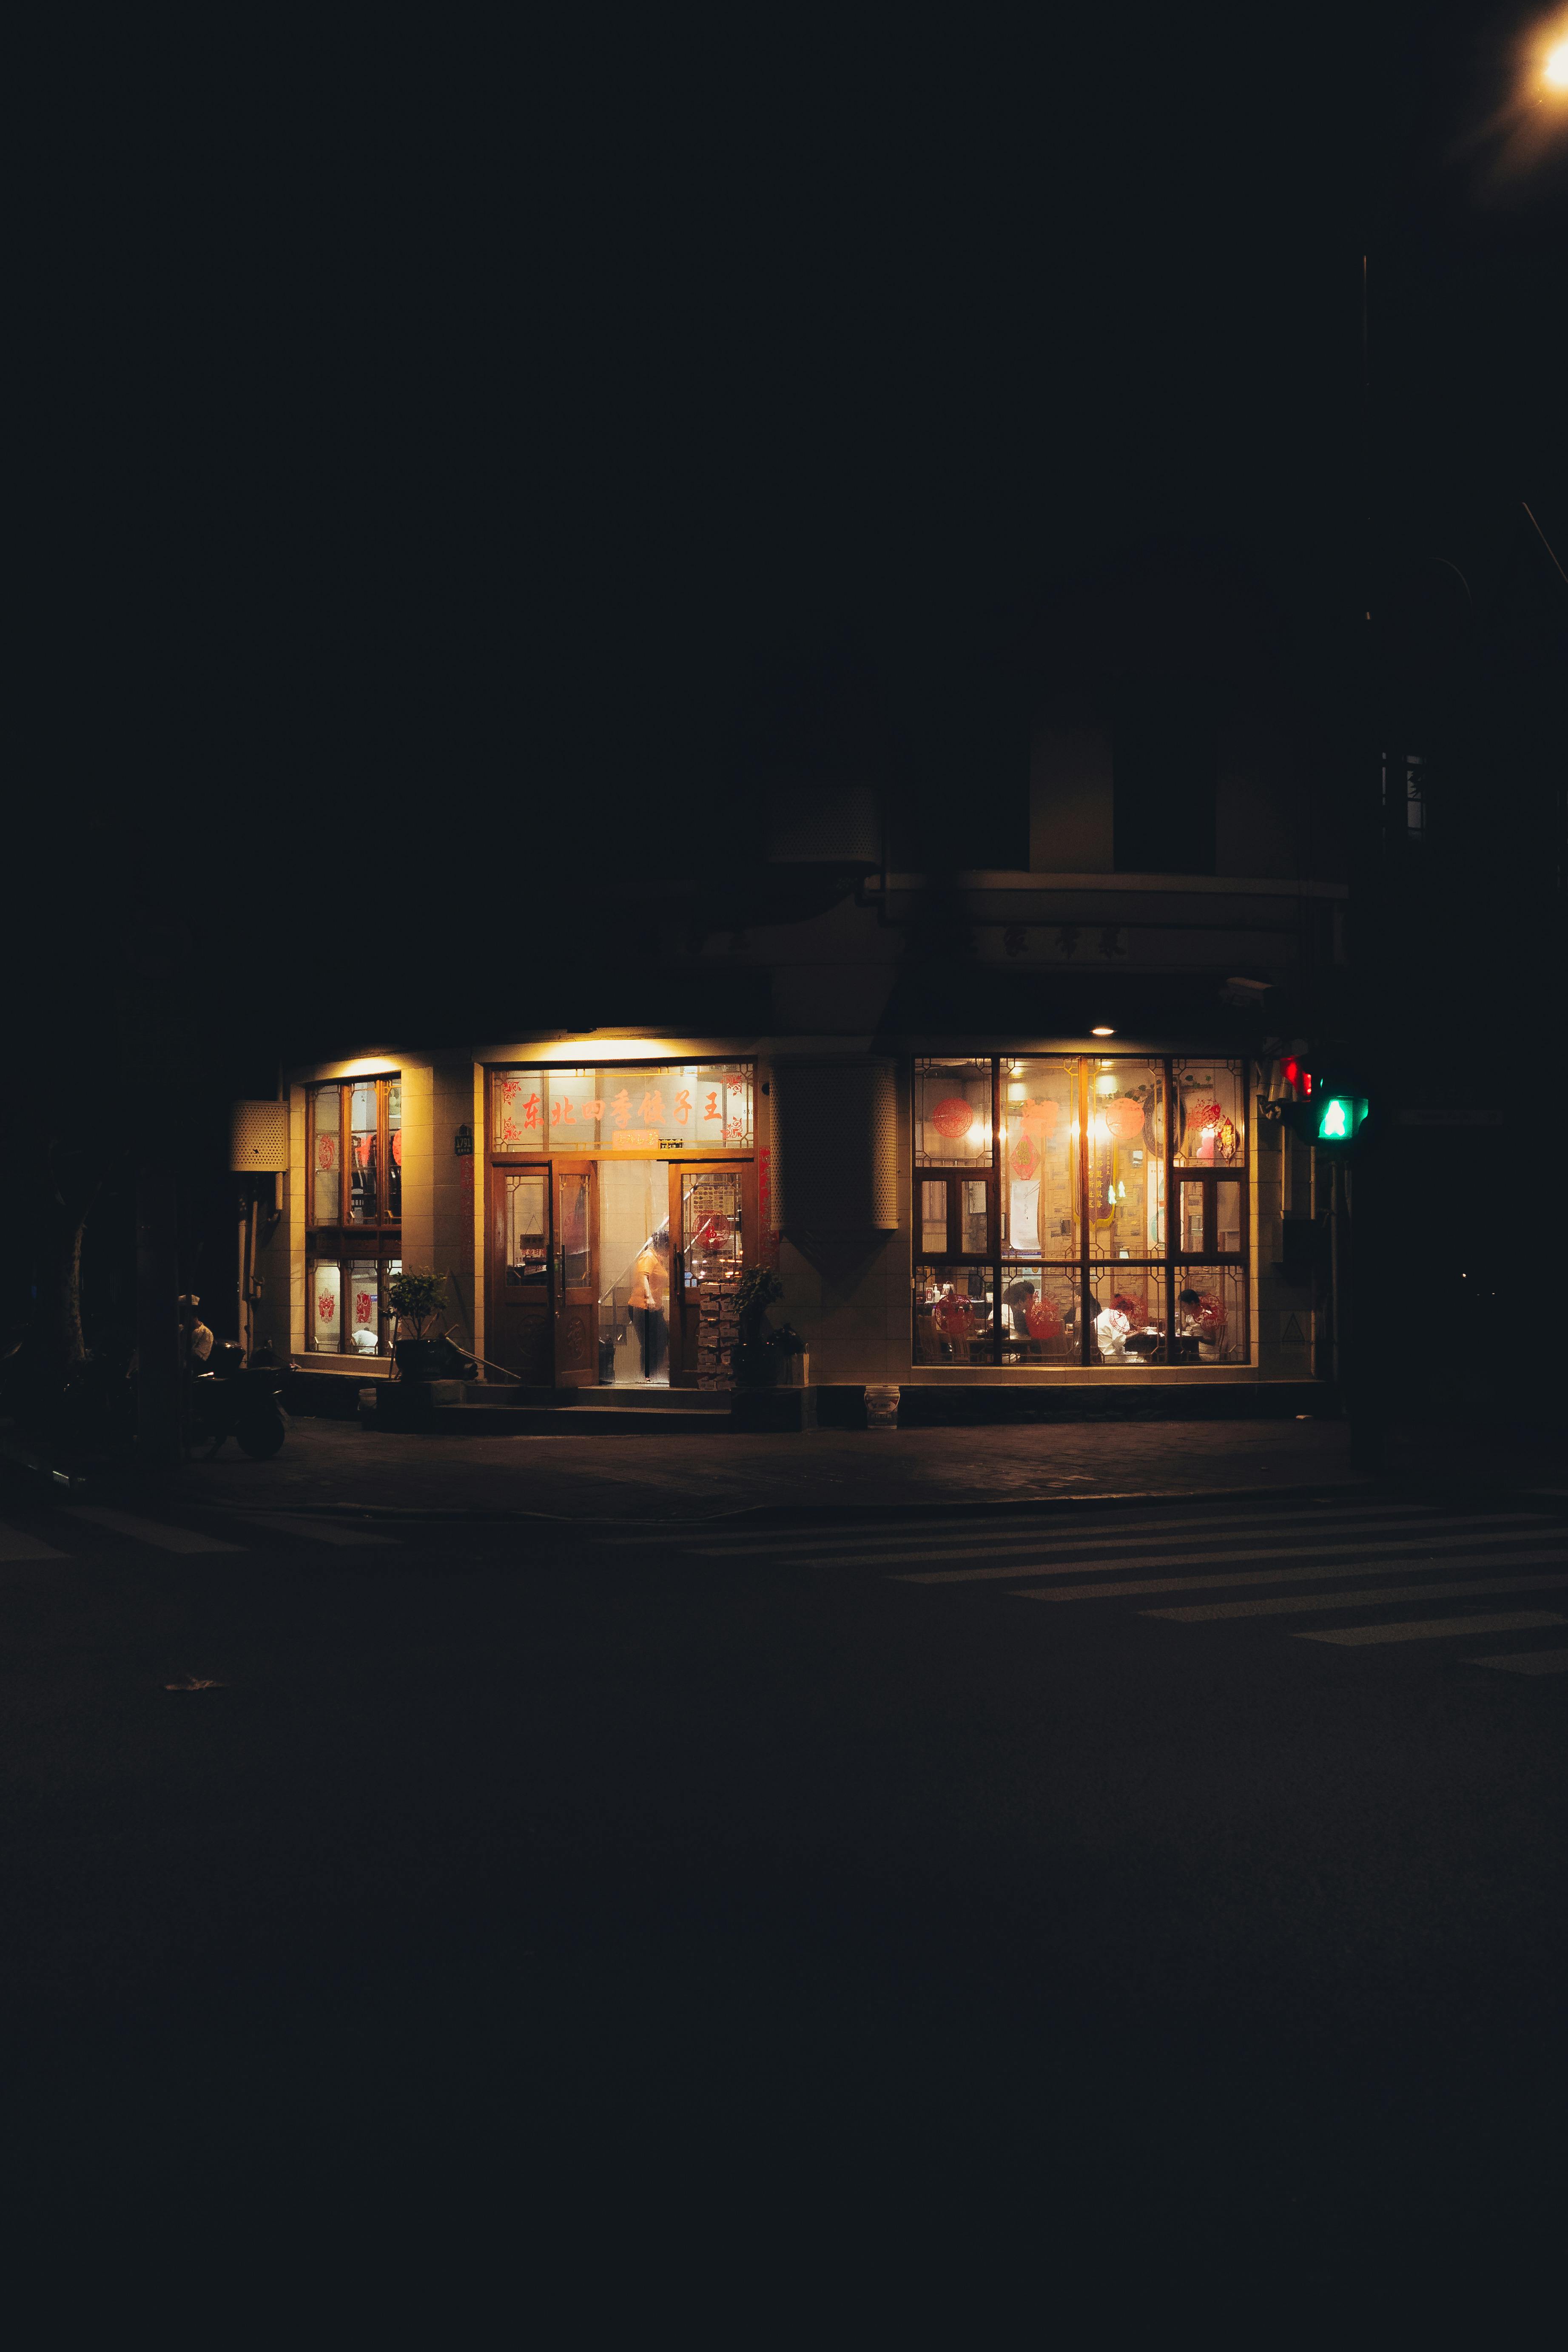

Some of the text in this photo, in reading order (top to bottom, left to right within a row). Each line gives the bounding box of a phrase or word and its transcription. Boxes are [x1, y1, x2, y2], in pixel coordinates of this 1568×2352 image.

[522, 1089, 722, 1129] 东北四季饺子王
